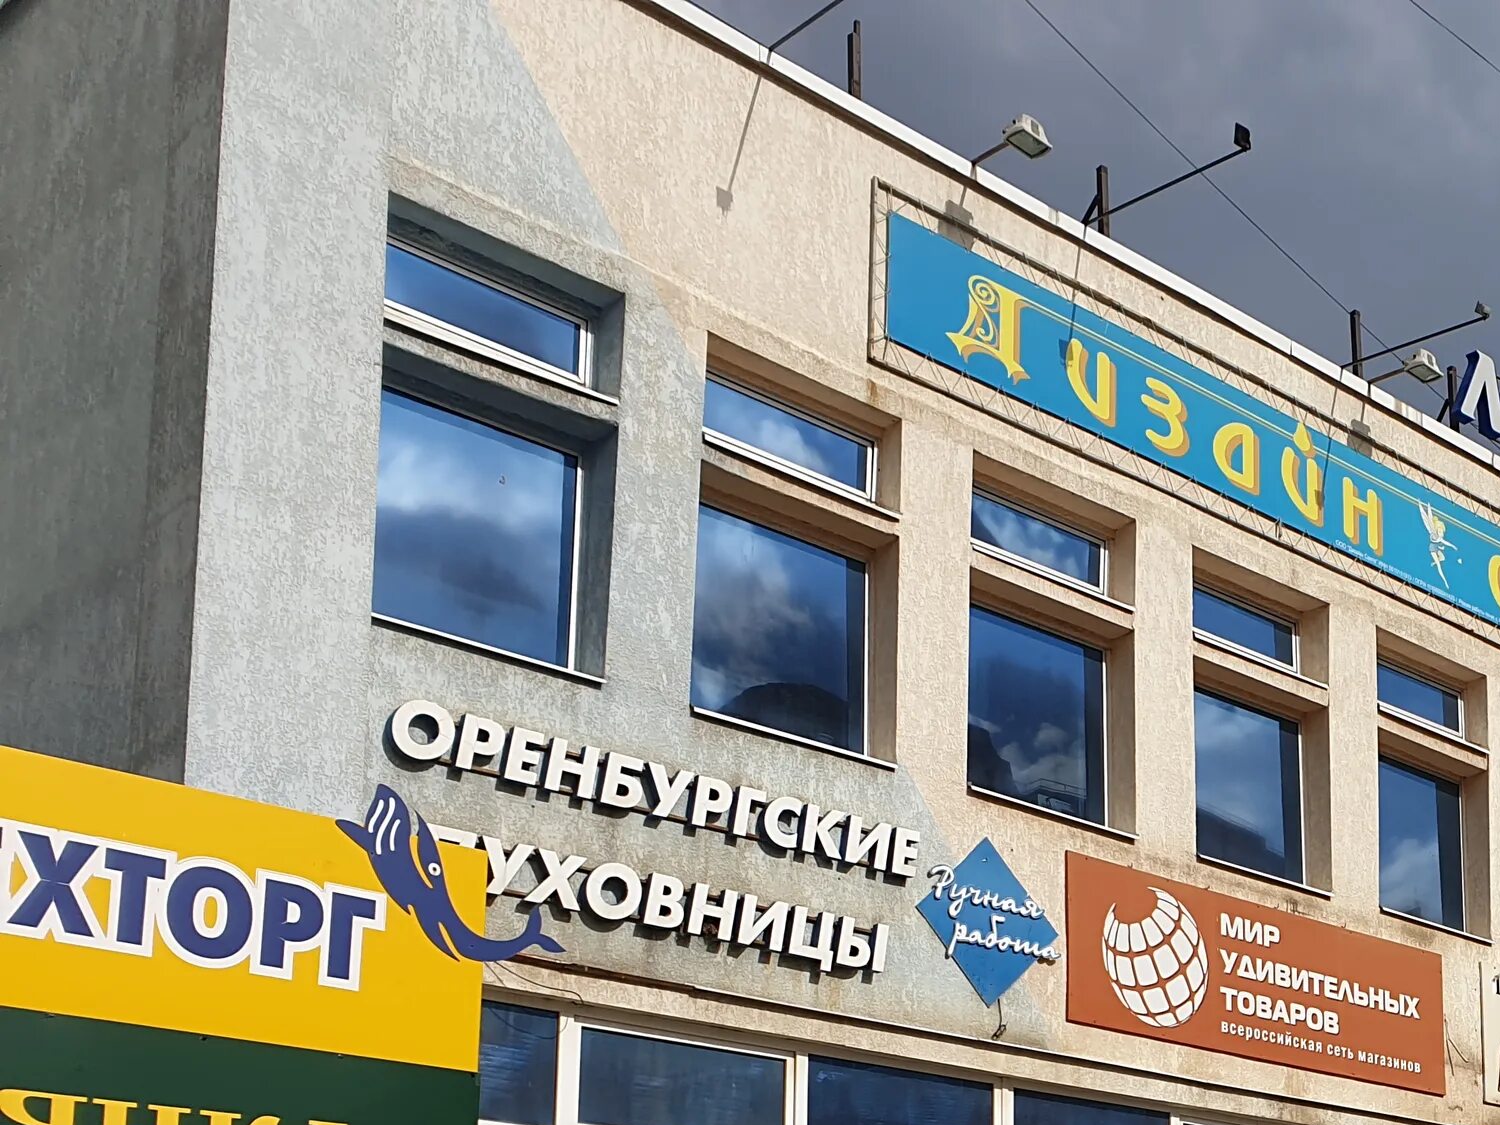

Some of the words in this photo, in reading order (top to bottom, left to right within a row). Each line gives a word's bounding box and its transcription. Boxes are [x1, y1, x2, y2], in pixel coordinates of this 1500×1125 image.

[391, 700, 921, 878] ОРЕНБУРГСКИЕ
[0, 821, 386, 989] ХТОРГ
[927, 865, 1044, 917] Ручная
[948, 915, 1061, 959] работа
[1220, 913, 1281, 947] МИР
[1219, 949, 1421, 1019] УДИВИТЕЛЬНЫХ
[1492, 975, 1500, 995] 1
[1220, 986, 1340, 1035] ТОВАРОВ
[1221, 1021, 1322, 1053] всероссийская
[1327, 1044, 1354, 1060] сеть
[1358, 1050, 1421, 1074] магазинов
